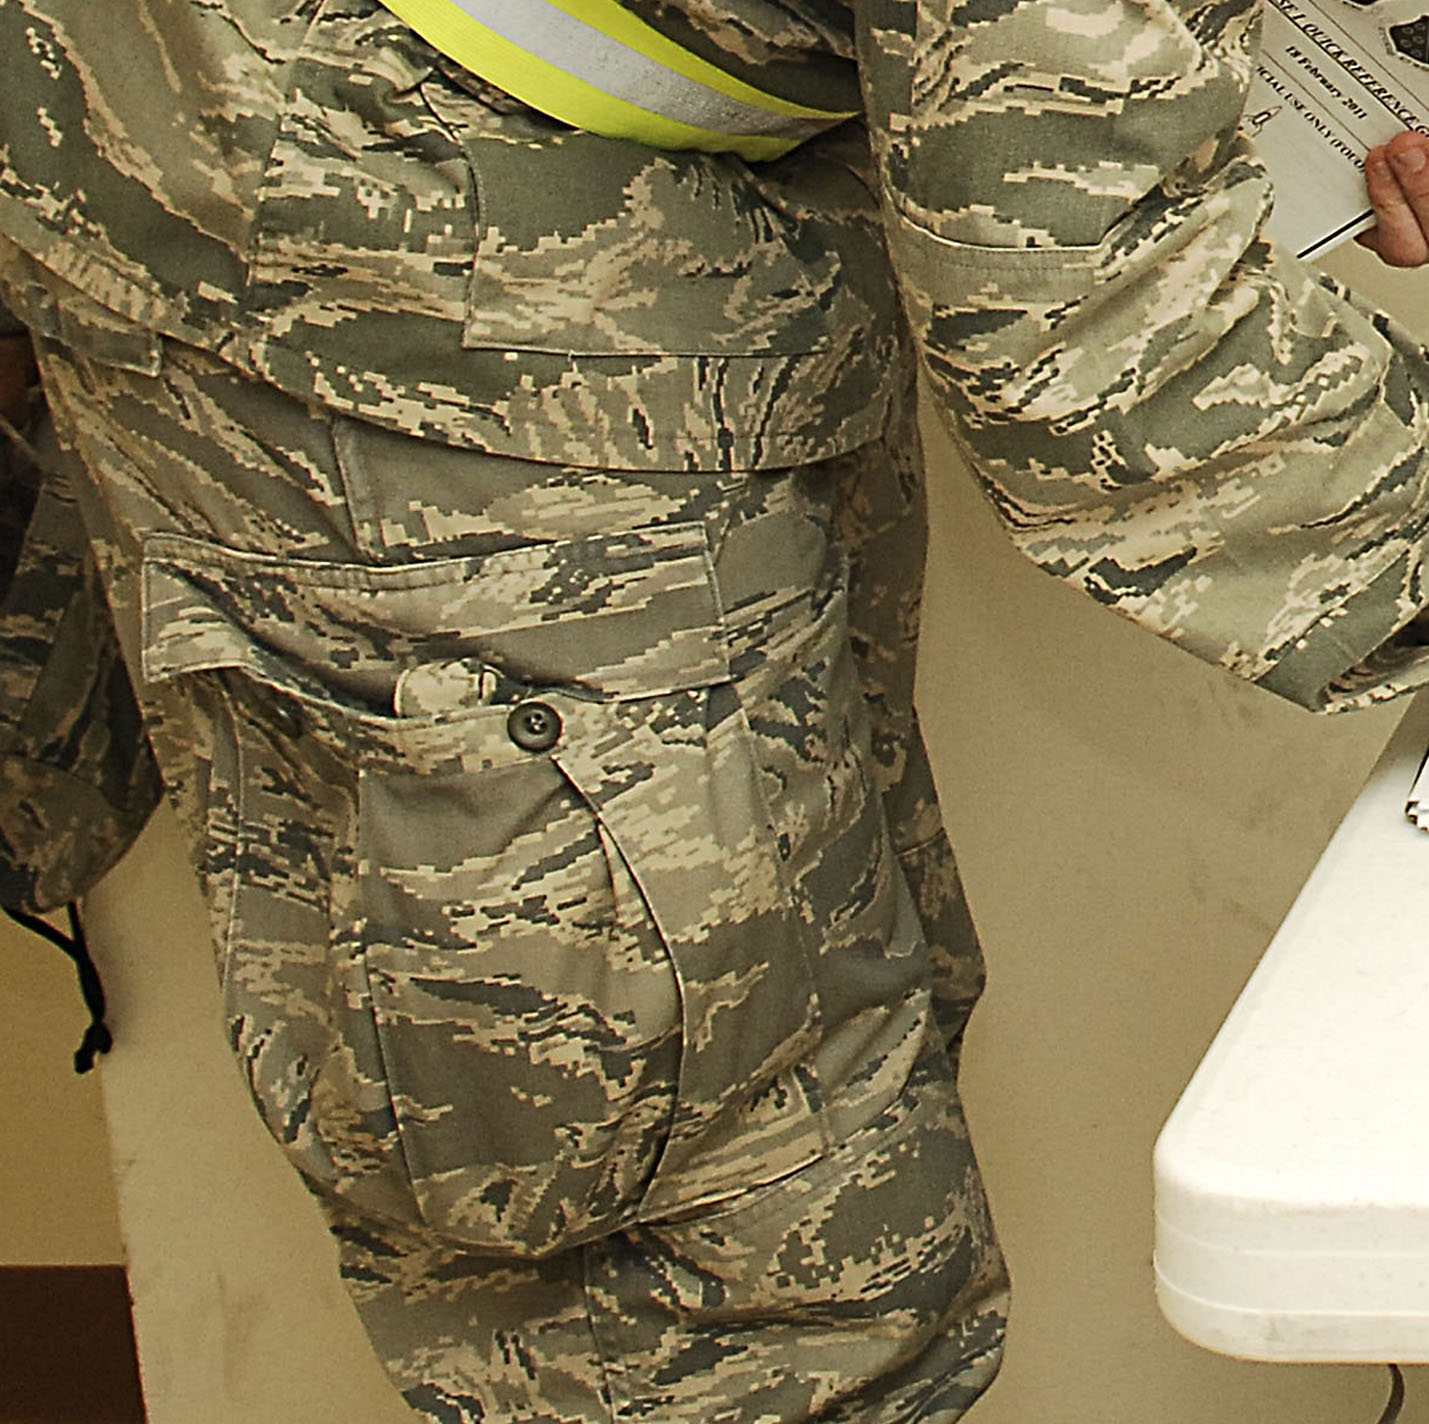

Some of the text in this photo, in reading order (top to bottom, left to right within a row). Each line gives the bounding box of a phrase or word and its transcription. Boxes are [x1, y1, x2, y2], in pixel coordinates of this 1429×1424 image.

[1256, 64, 1285, 95] ICIAL
[1284, 92, 1307, 114] USE
[1303, 110, 1334, 140] ONLY
[1298, 54, 1342, 101] February
[1341, 97, 1369, 120] 2011
[1302, 23, 1347, 61] QUICK
[1342, 54, 1420, 125] REFERENCE
